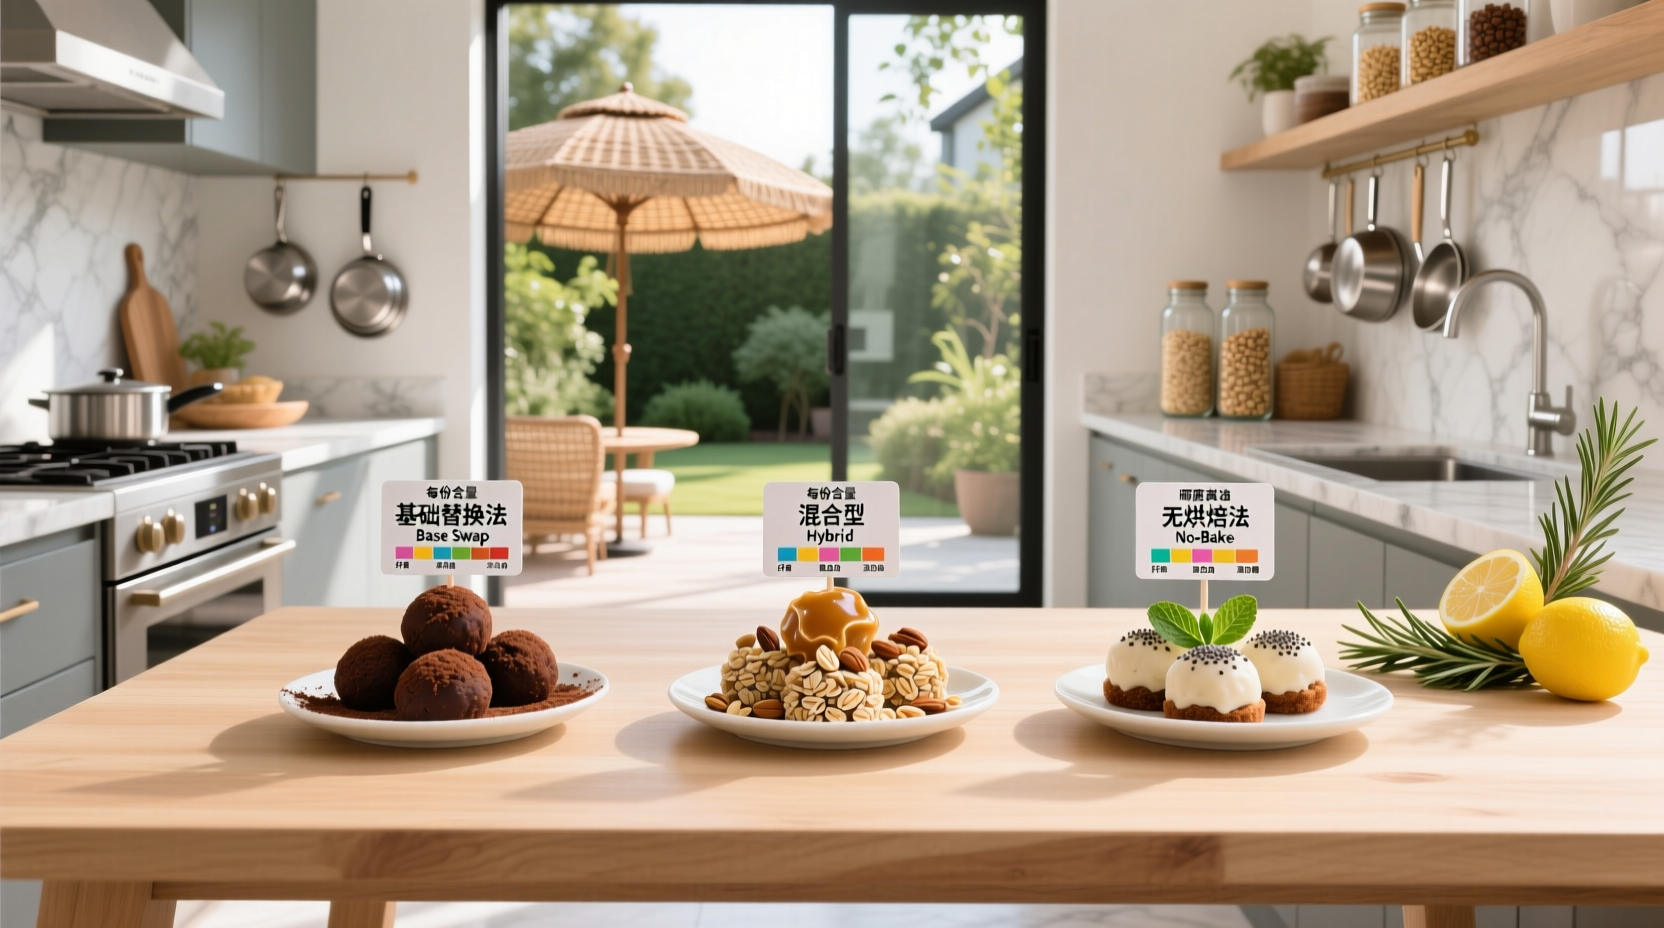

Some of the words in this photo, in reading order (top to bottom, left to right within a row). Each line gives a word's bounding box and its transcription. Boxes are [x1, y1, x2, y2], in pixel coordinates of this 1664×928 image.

[395, 502, 507, 526] 基础替换法
[799, 503, 865, 526] 混合型
[1162, 504, 1250, 528] 无烘焙法
[416, 529, 448, 542] Base
[452, 529, 490, 546] Swap
[807, 528, 854, 545] Hybrid
[1175, 530, 1235, 544] No-Bake
